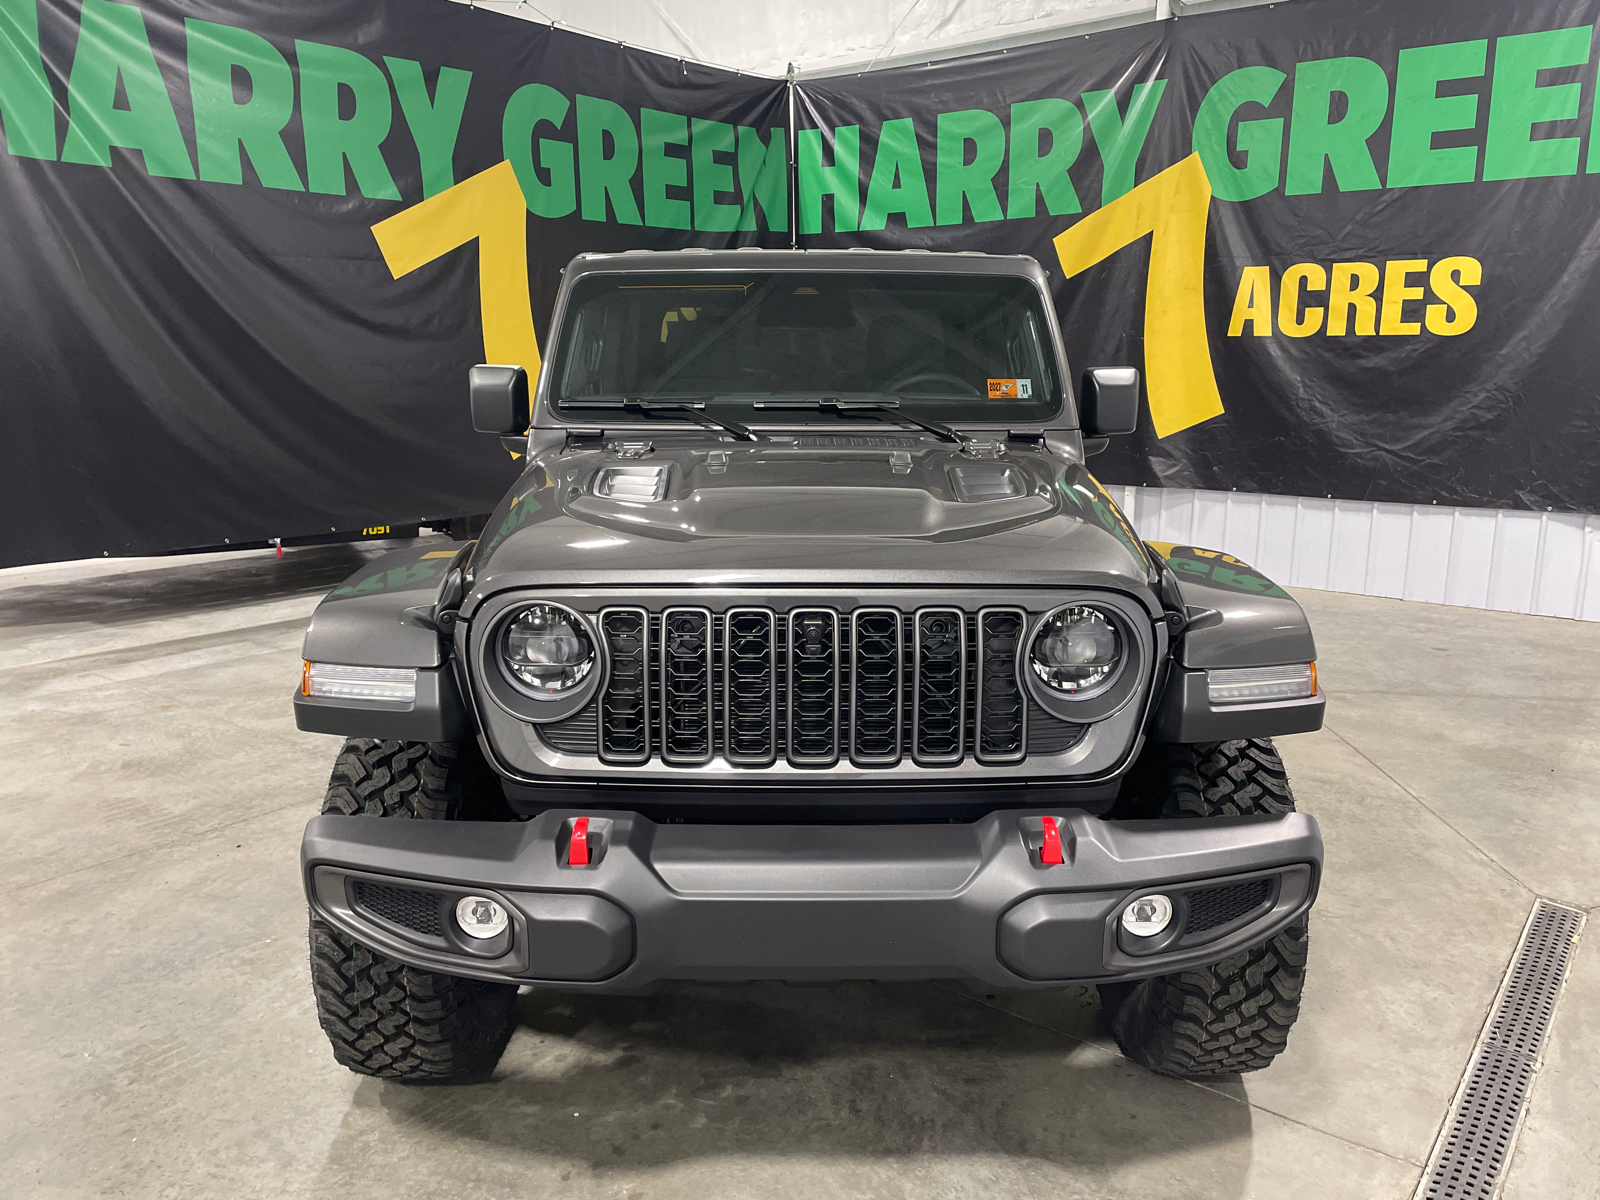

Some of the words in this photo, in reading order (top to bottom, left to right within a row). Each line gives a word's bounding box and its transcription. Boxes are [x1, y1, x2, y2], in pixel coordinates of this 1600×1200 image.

[503, 83, 788, 232] GREEN
[798, 78, 1168, 235] HARRY
[1193, 24, 1600, 202] GREE
[370, 159, 542, 460] 7
[989, 382, 1001, 392] 2027
[1021, 383, 1029, 395] 11
[1053, 151, 1225, 439] 7
[1227, 256, 1482, 337] ACRES
